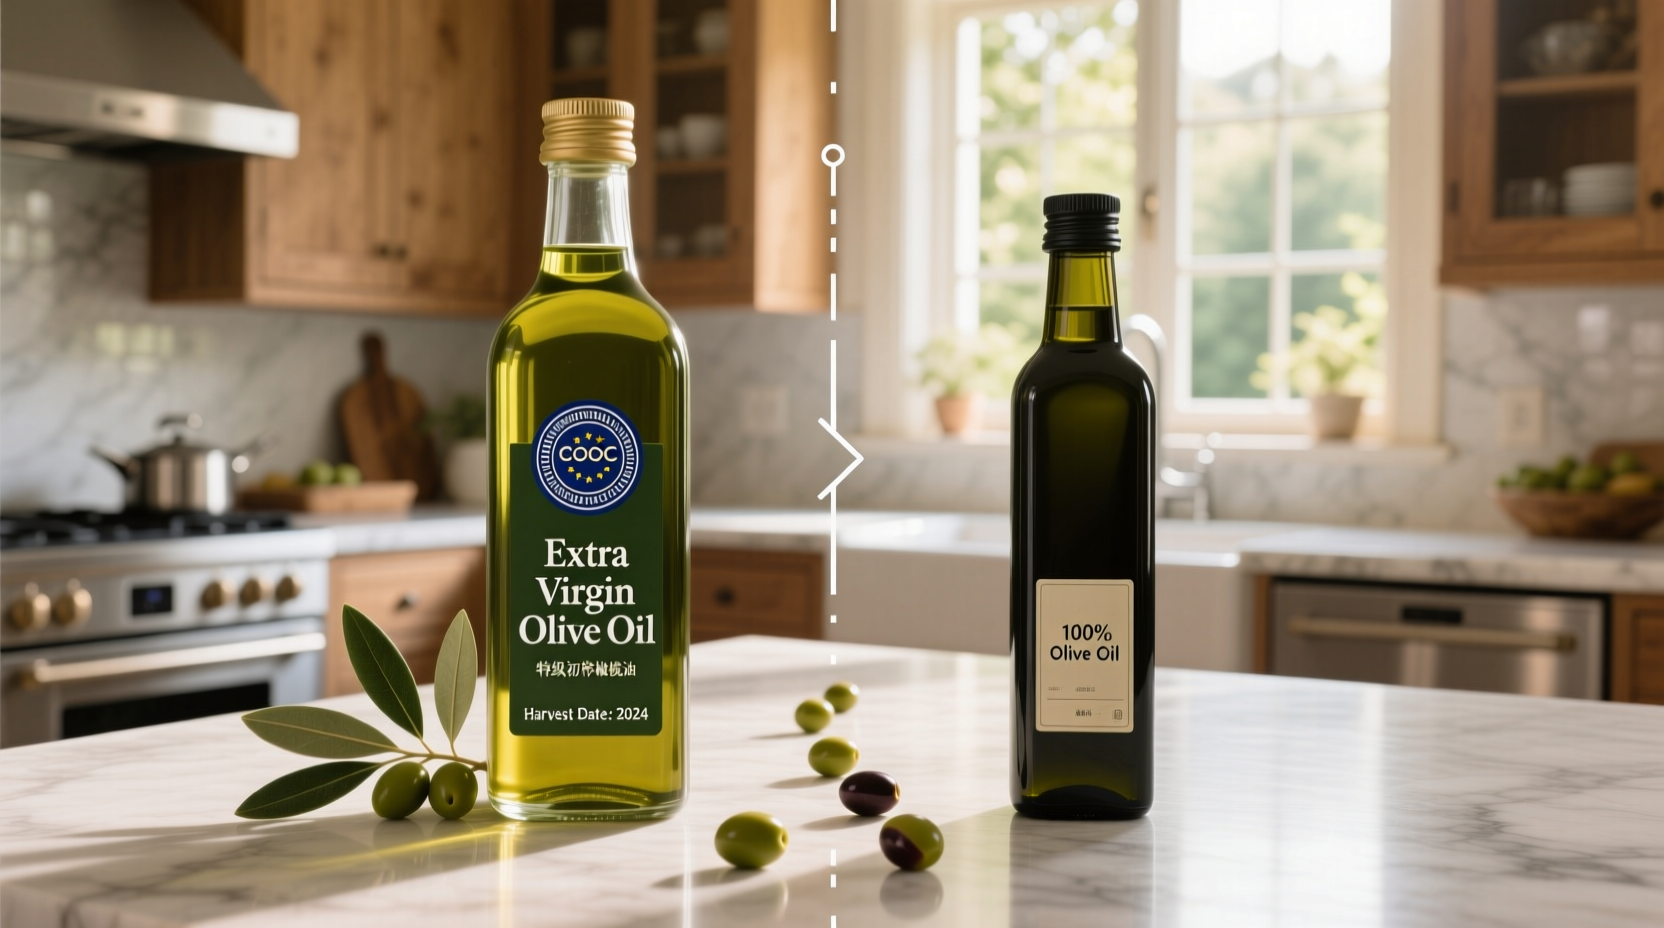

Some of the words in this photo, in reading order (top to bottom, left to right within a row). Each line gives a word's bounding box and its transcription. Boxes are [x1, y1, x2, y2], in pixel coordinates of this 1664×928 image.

[559, 445, 618, 462] COOC
[544, 538, 629, 567] Extra
[535, 576, 636, 613] Virgin
[519, 613, 600, 645] Olive
[606, 614, 655, 645] Oil
[1062, 624, 1112, 641] 100%
[1050, 644, 1091, 661] Olive
[1096, 645, 1119, 662] Oil
[524, 707, 574, 721] Harvest
[577, 707, 613, 721] Date:
[616, 707, 649, 721] 2024
